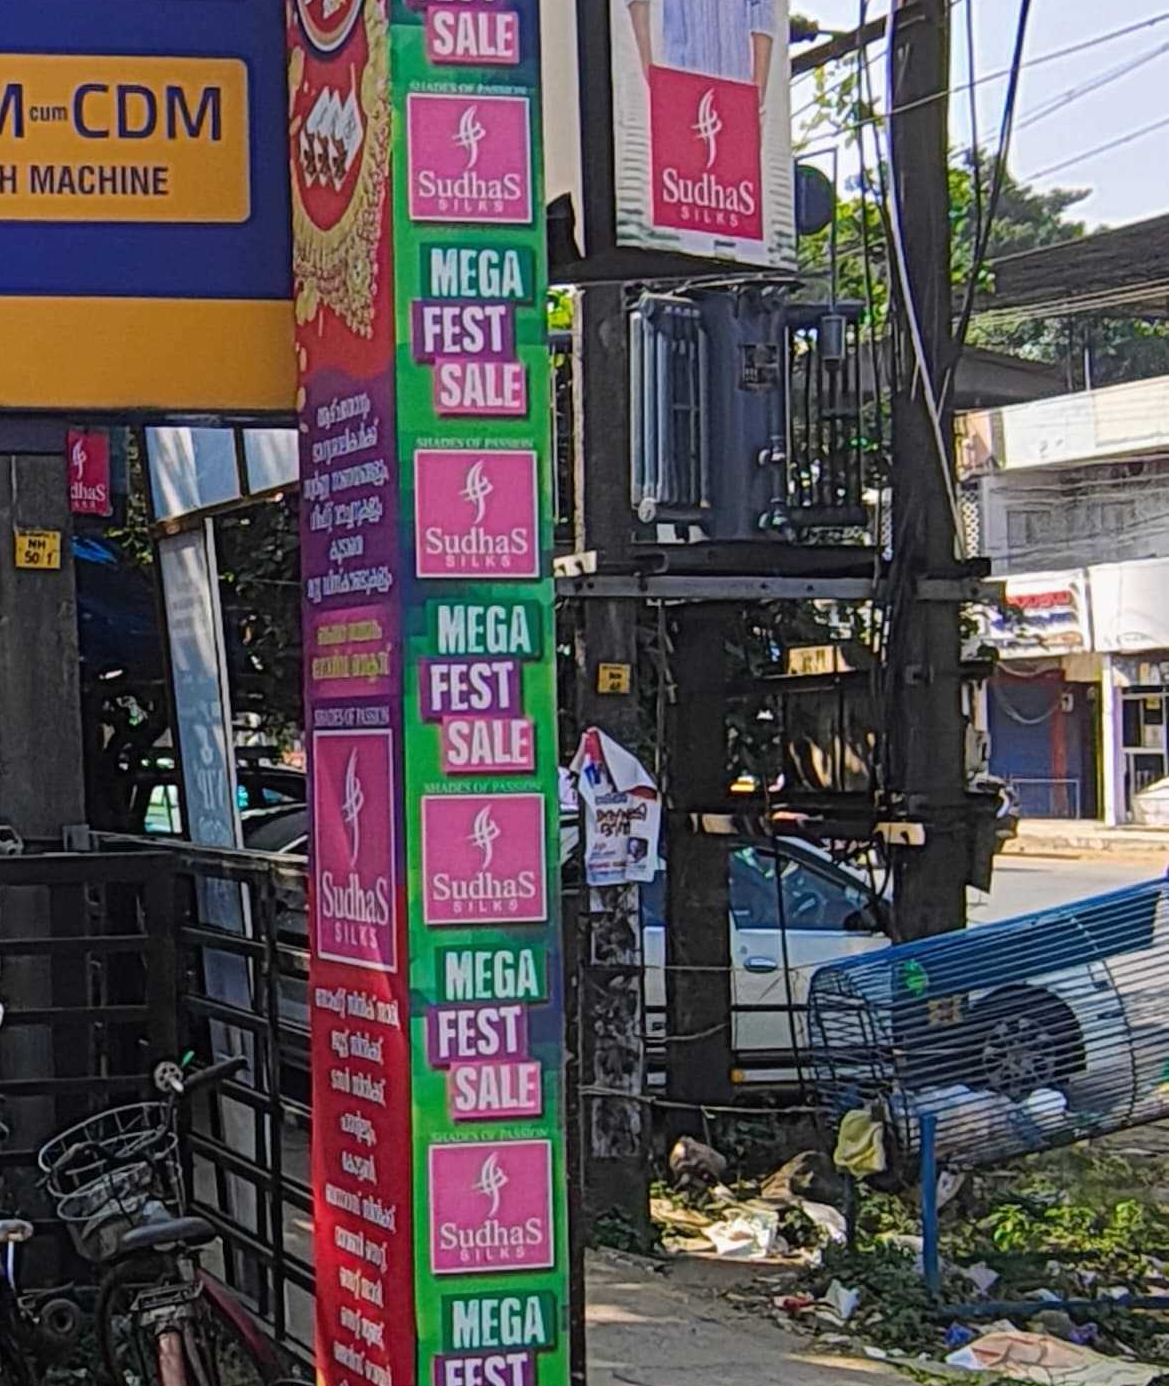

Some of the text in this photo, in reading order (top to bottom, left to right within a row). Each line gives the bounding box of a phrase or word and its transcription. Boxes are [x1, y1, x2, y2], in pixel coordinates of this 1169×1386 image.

[433, 12, 514, 57] SALE
[29, 104, 69, 123] cum
[72, 83, 223, 142] CDM
[30, 165, 169, 197] MACHINE
[418, 171, 521, 200] SudhaS
[662, 167, 755, 215] SudhaS
[681, 205, 738, 227] SILKS
[430, 248, 524, 297] MEGA
[423, 306, 506, 353] FEST
[440, 363, 521, 407] SALE
[69, 481, 107, 502] dhaS
[425, 526, 528, 555] SudhaS
[438, 604, 531, 655] MEGA
[431, 662, 514, 710] FEST
[448, 720, 528, 765] SALE
[321, 869, 389, 927] SudhaS
[433, 870, 536, 901] SudhaS
[334, 923, 378, 951] SILKS
[445, 948, 539, 1000] MEGA
[438, 1006, 522, 1059] FEST
[454, 1062, 536, 1110] SALE
[440, 1216, 543, 1250] SudhaS
[451, 1295, 545, 1349] MEGA
